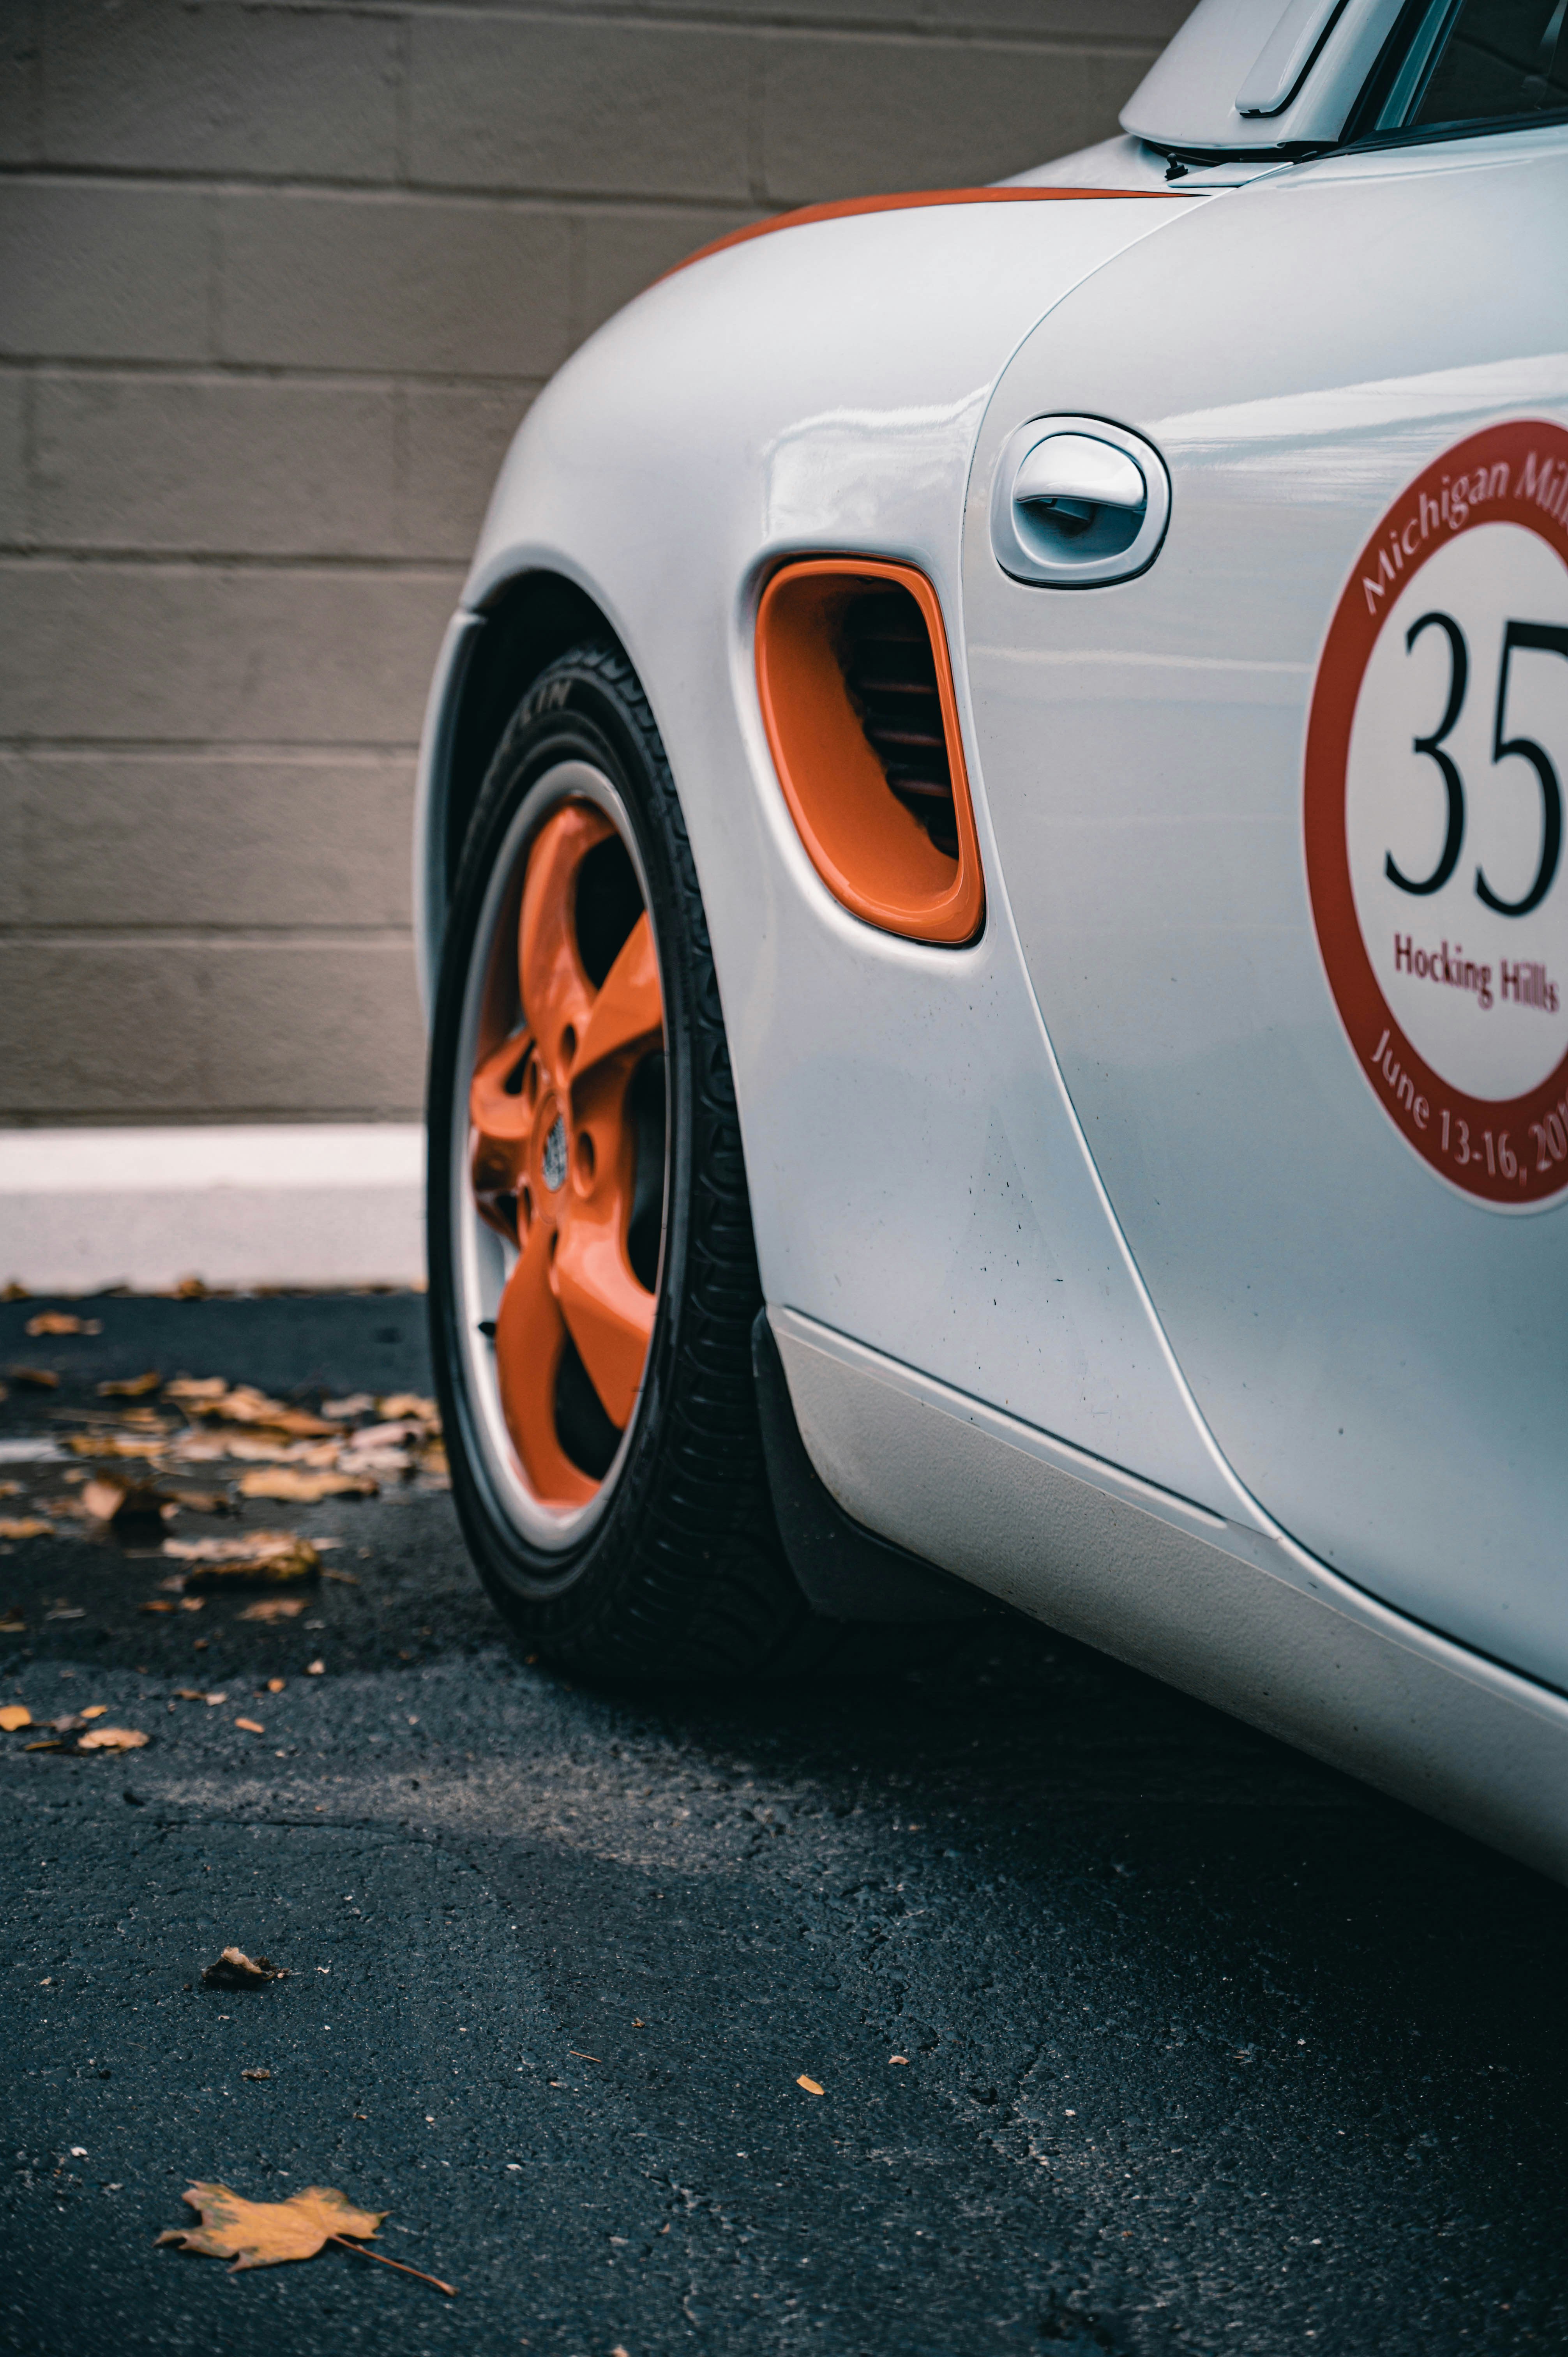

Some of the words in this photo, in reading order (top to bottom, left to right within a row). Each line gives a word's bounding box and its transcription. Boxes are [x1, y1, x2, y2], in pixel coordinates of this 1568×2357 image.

[1363, 461, 1510, 615] Michigan
[1514, 449, 1568, 526] Mil
[1384, 611, 1568, 918] 35
[1394, 933, 1494, 1011] Hocking
[1500, 957, 1560, 1014] Hills
[1370, 1028, 1430, 1129] June
[1440, 1109, 1527, 1186] 13-16,
[1528, 1087, 1568, 1172] 201
